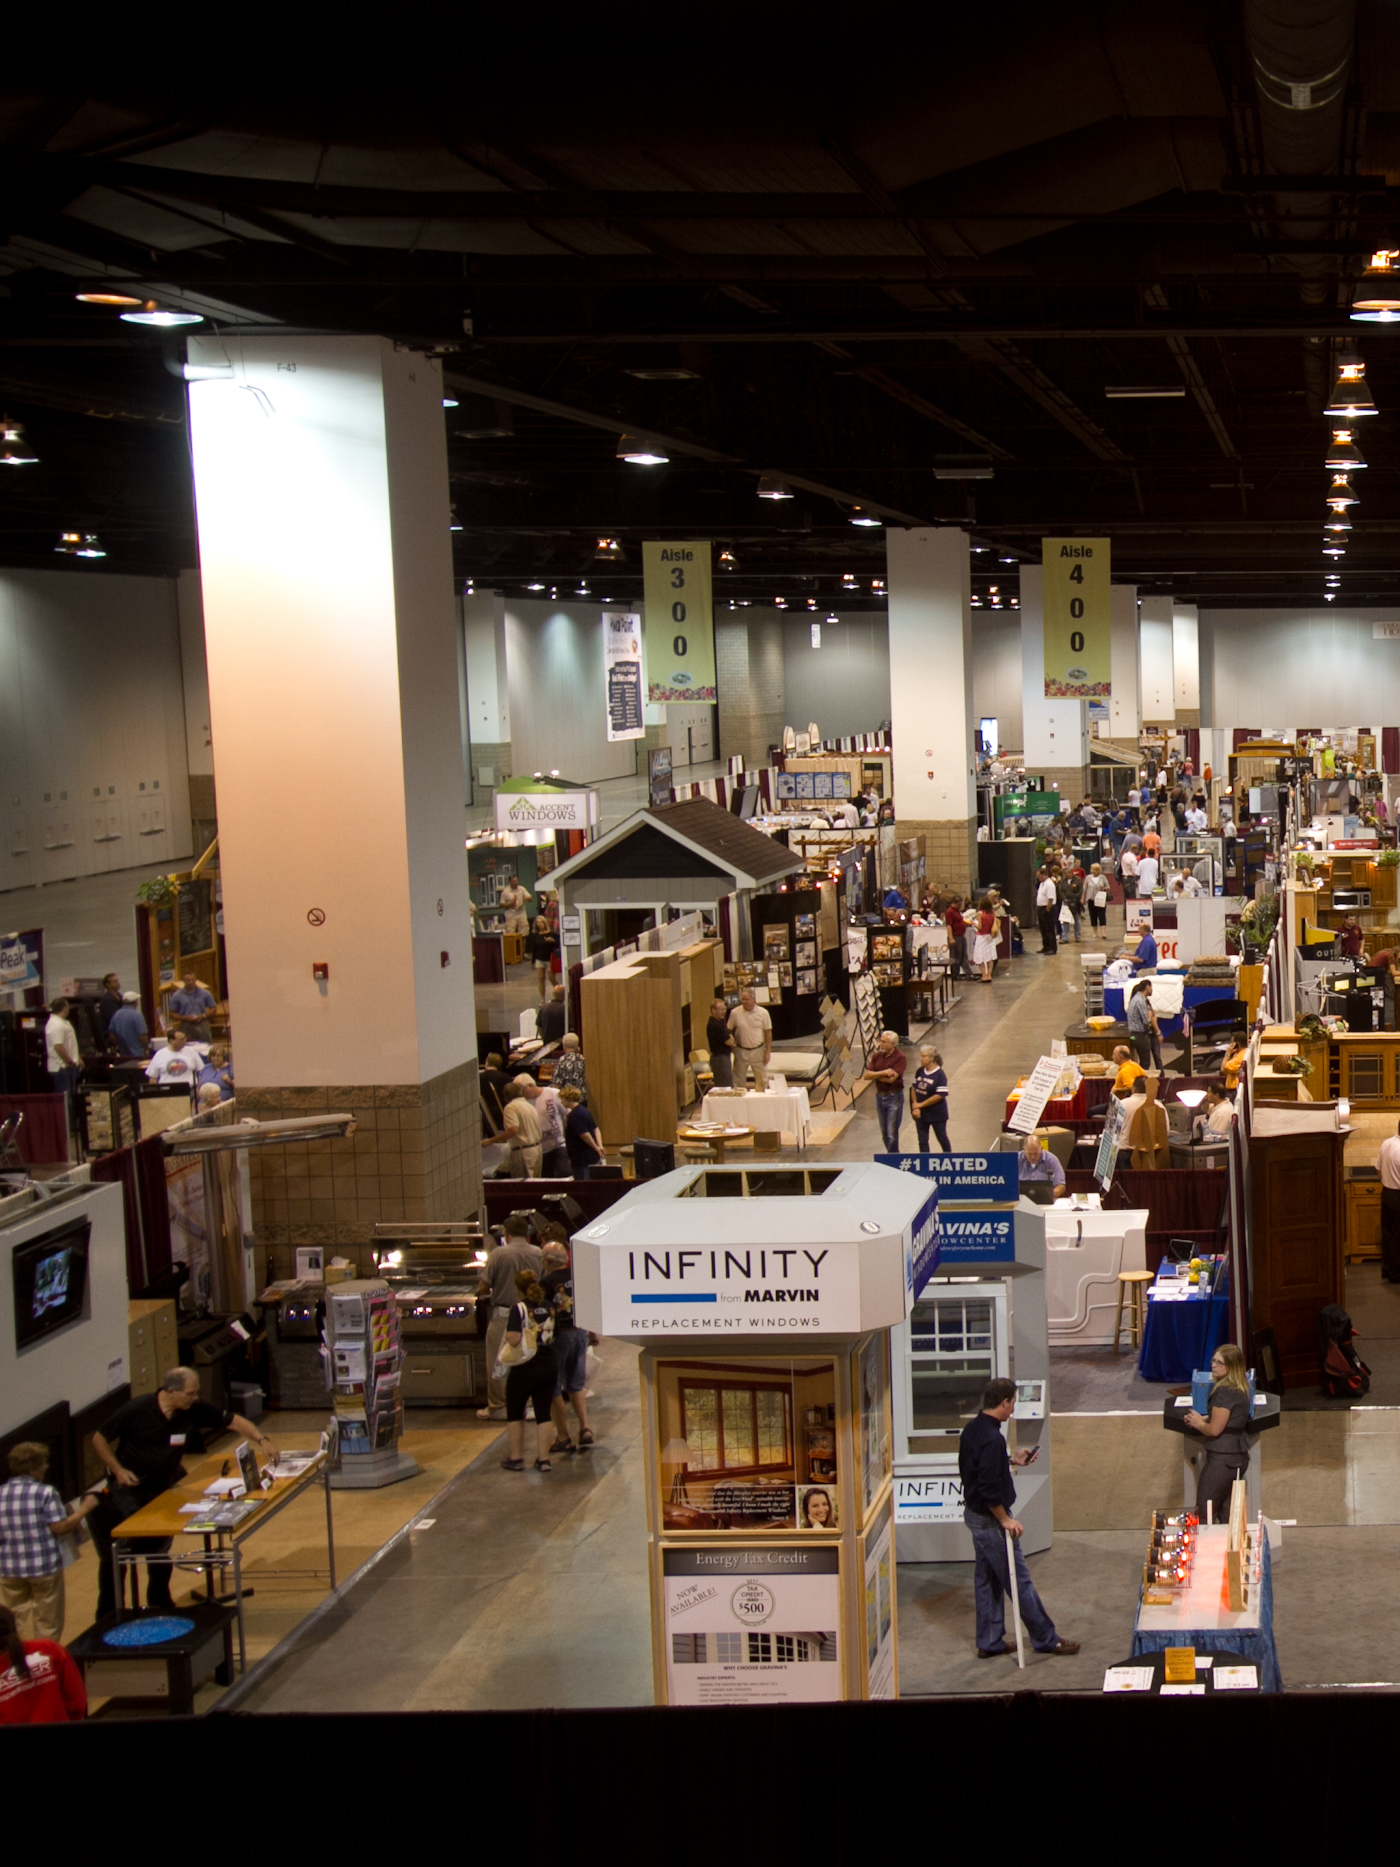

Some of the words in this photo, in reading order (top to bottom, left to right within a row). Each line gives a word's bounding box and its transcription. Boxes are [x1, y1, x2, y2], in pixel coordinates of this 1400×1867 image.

[660, 548, 694, 562] Aisle
[1060, 546, 1092, 558] Aisle
[509, 811, 576, 820] WINDOWS
[0, 946, 26, 968] Peak
[899, 1158, 920, 1171] #1
[928, 1158, 988, 1171] RATED
[939, 1176, 952, 1185] IN
[954, 1176, 1005, 1185] AMERICA
[939, 1222, 1010, 1235] AVINA'S
[628, 1250, 829, 1280] INFINITY
[720, 1293, 741, 1303] from
[744, 1289, 819, 1302] MARVIN
[631, 1318, 742, 1328] REPLACEMENT
[749, 1317, 820, 1327] WINDOWS
[900, 1482, 963, 1496] INFIN
[696, 1552, 740, 1568] Energy
[742, 1553, 764, 1564] Tax
[767, 1552, 808, 1564] Credit
[676, 1585, 698, 1600] NOW
[670, 1587, 717, 1614] AVAILABLE!
[739, 1603, 764, 1614] $500
